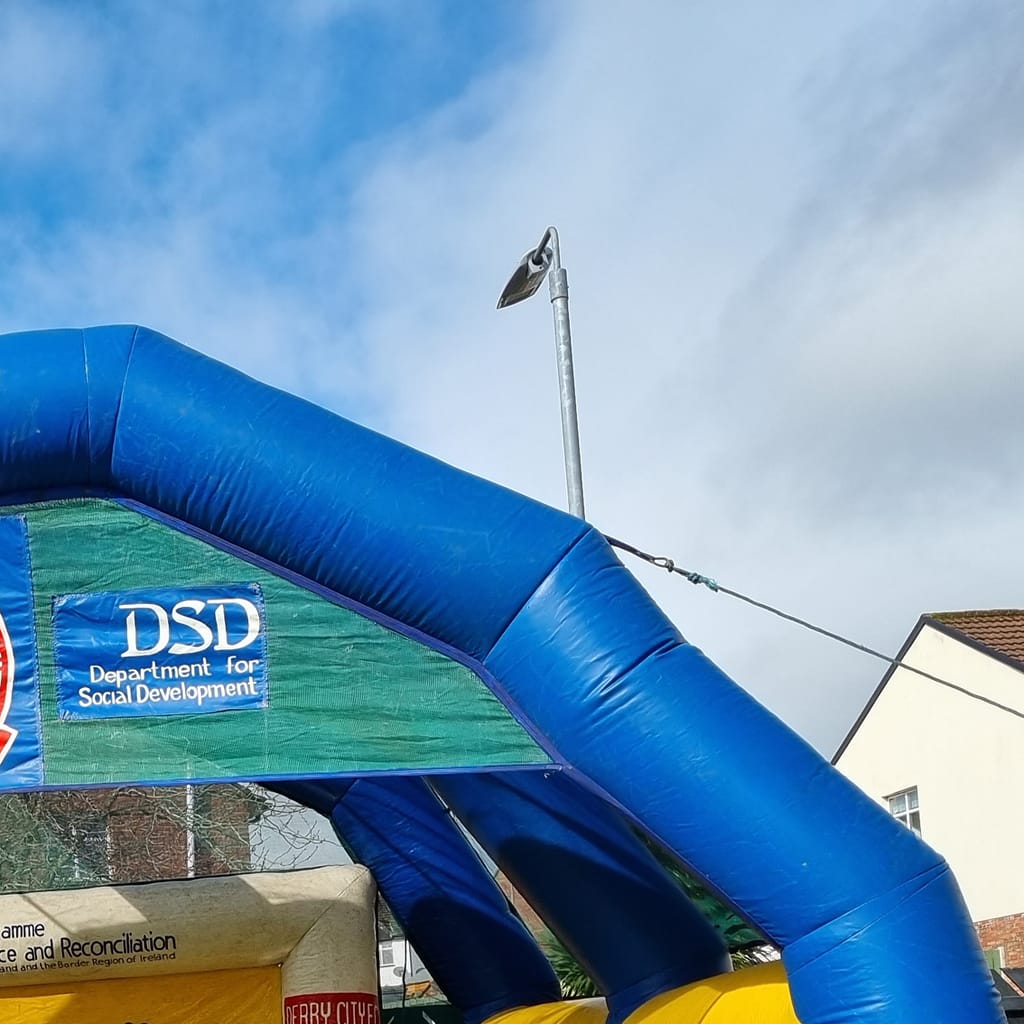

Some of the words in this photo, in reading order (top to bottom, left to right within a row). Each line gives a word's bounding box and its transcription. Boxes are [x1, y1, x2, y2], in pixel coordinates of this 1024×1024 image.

[119, 598, 260, 657] DSD
[90, 657, 211, 688] Department
[227, 655, 259, 674] for
[79, 686, 132, 708] Social
[136, 676, 258, 705] Development
[20, 962, 38, 971] and
[39, 962, 57, 970] the
[92, 957, 124, 967] Region
[127, 955, 137, 963] of
[140, 952, 176, 962] Ireland
[25, 938, 55, 961] and
[60, 931, 176, 958] Reconciliation
